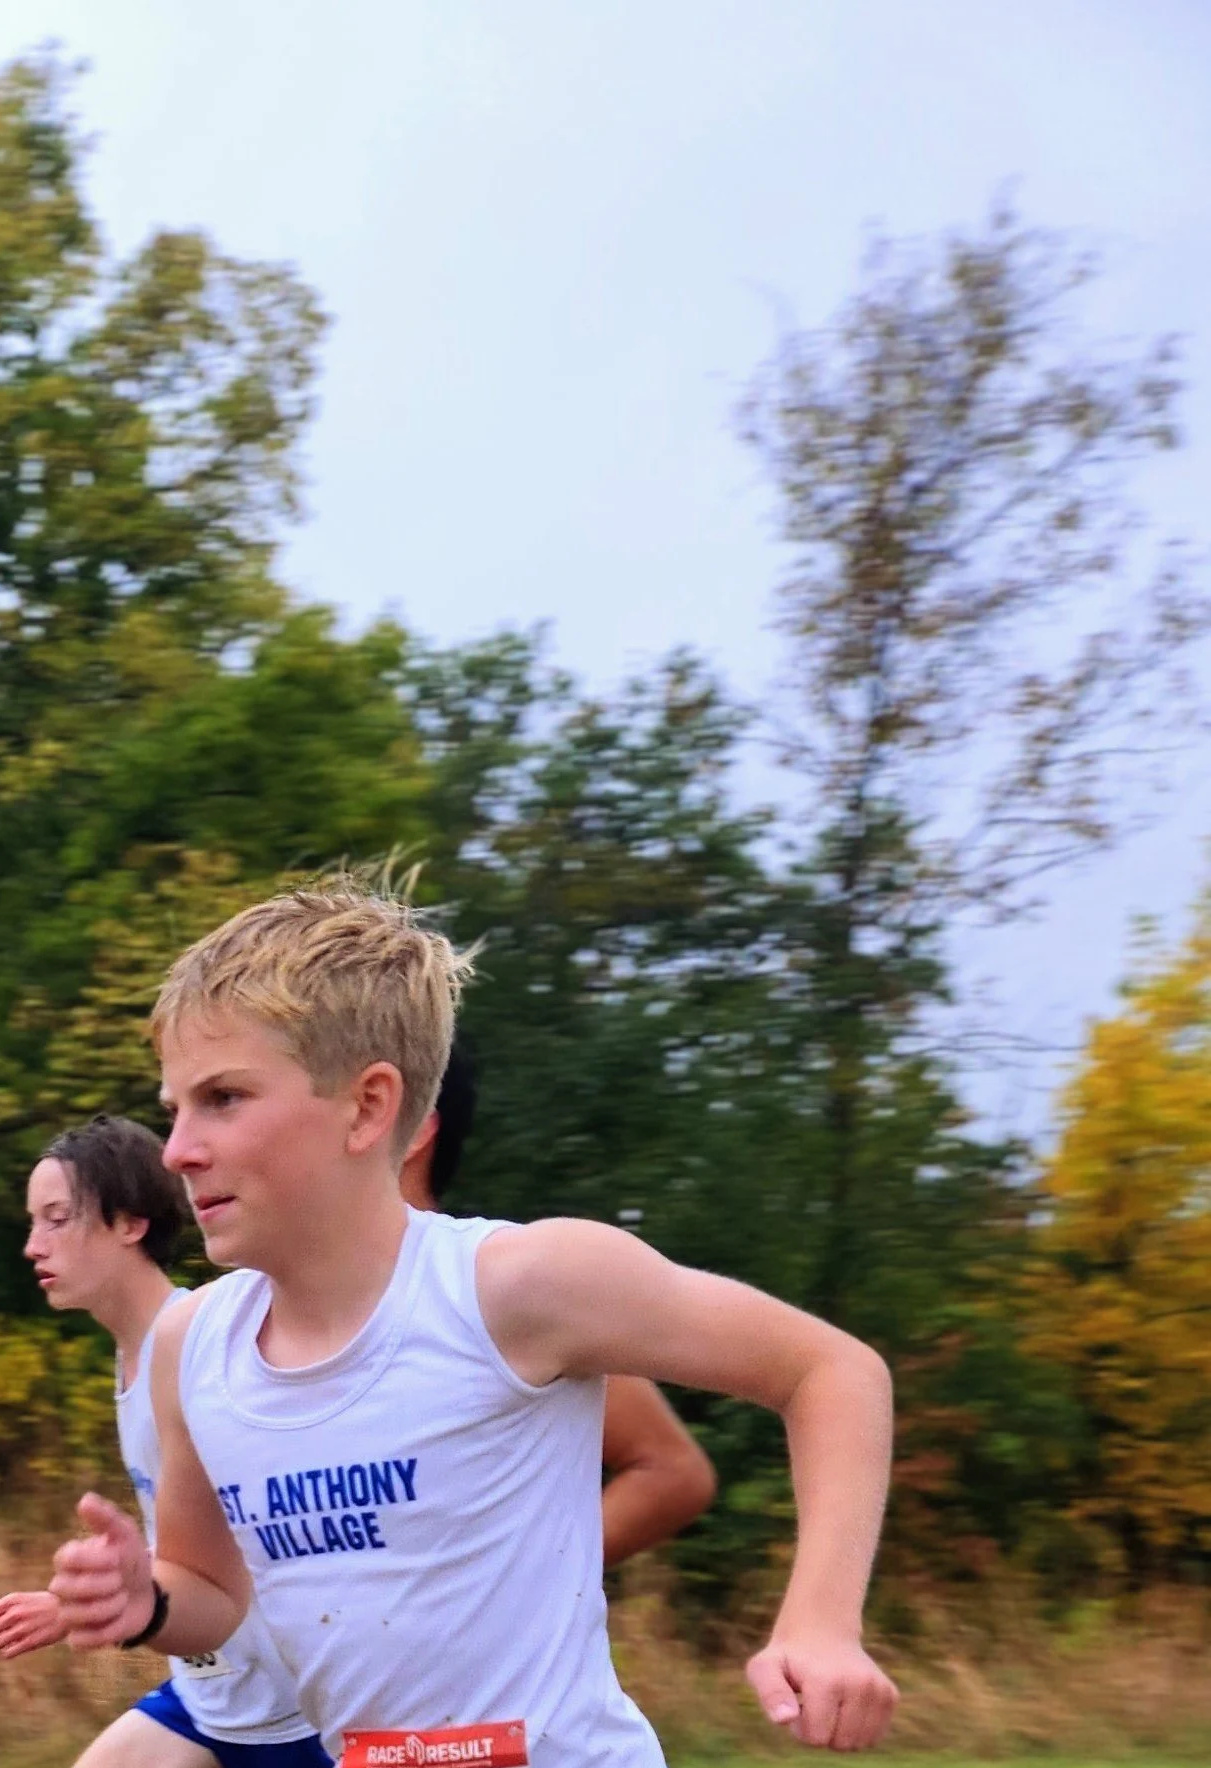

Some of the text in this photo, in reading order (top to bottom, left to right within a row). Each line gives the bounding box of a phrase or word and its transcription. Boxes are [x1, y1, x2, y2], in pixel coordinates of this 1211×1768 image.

[266, 1458, 418, 1519] ANTHONY
[255, 1512, 387, 1560] VILLAGE
[366, 1737, 494, 1764] RACE RESULT
